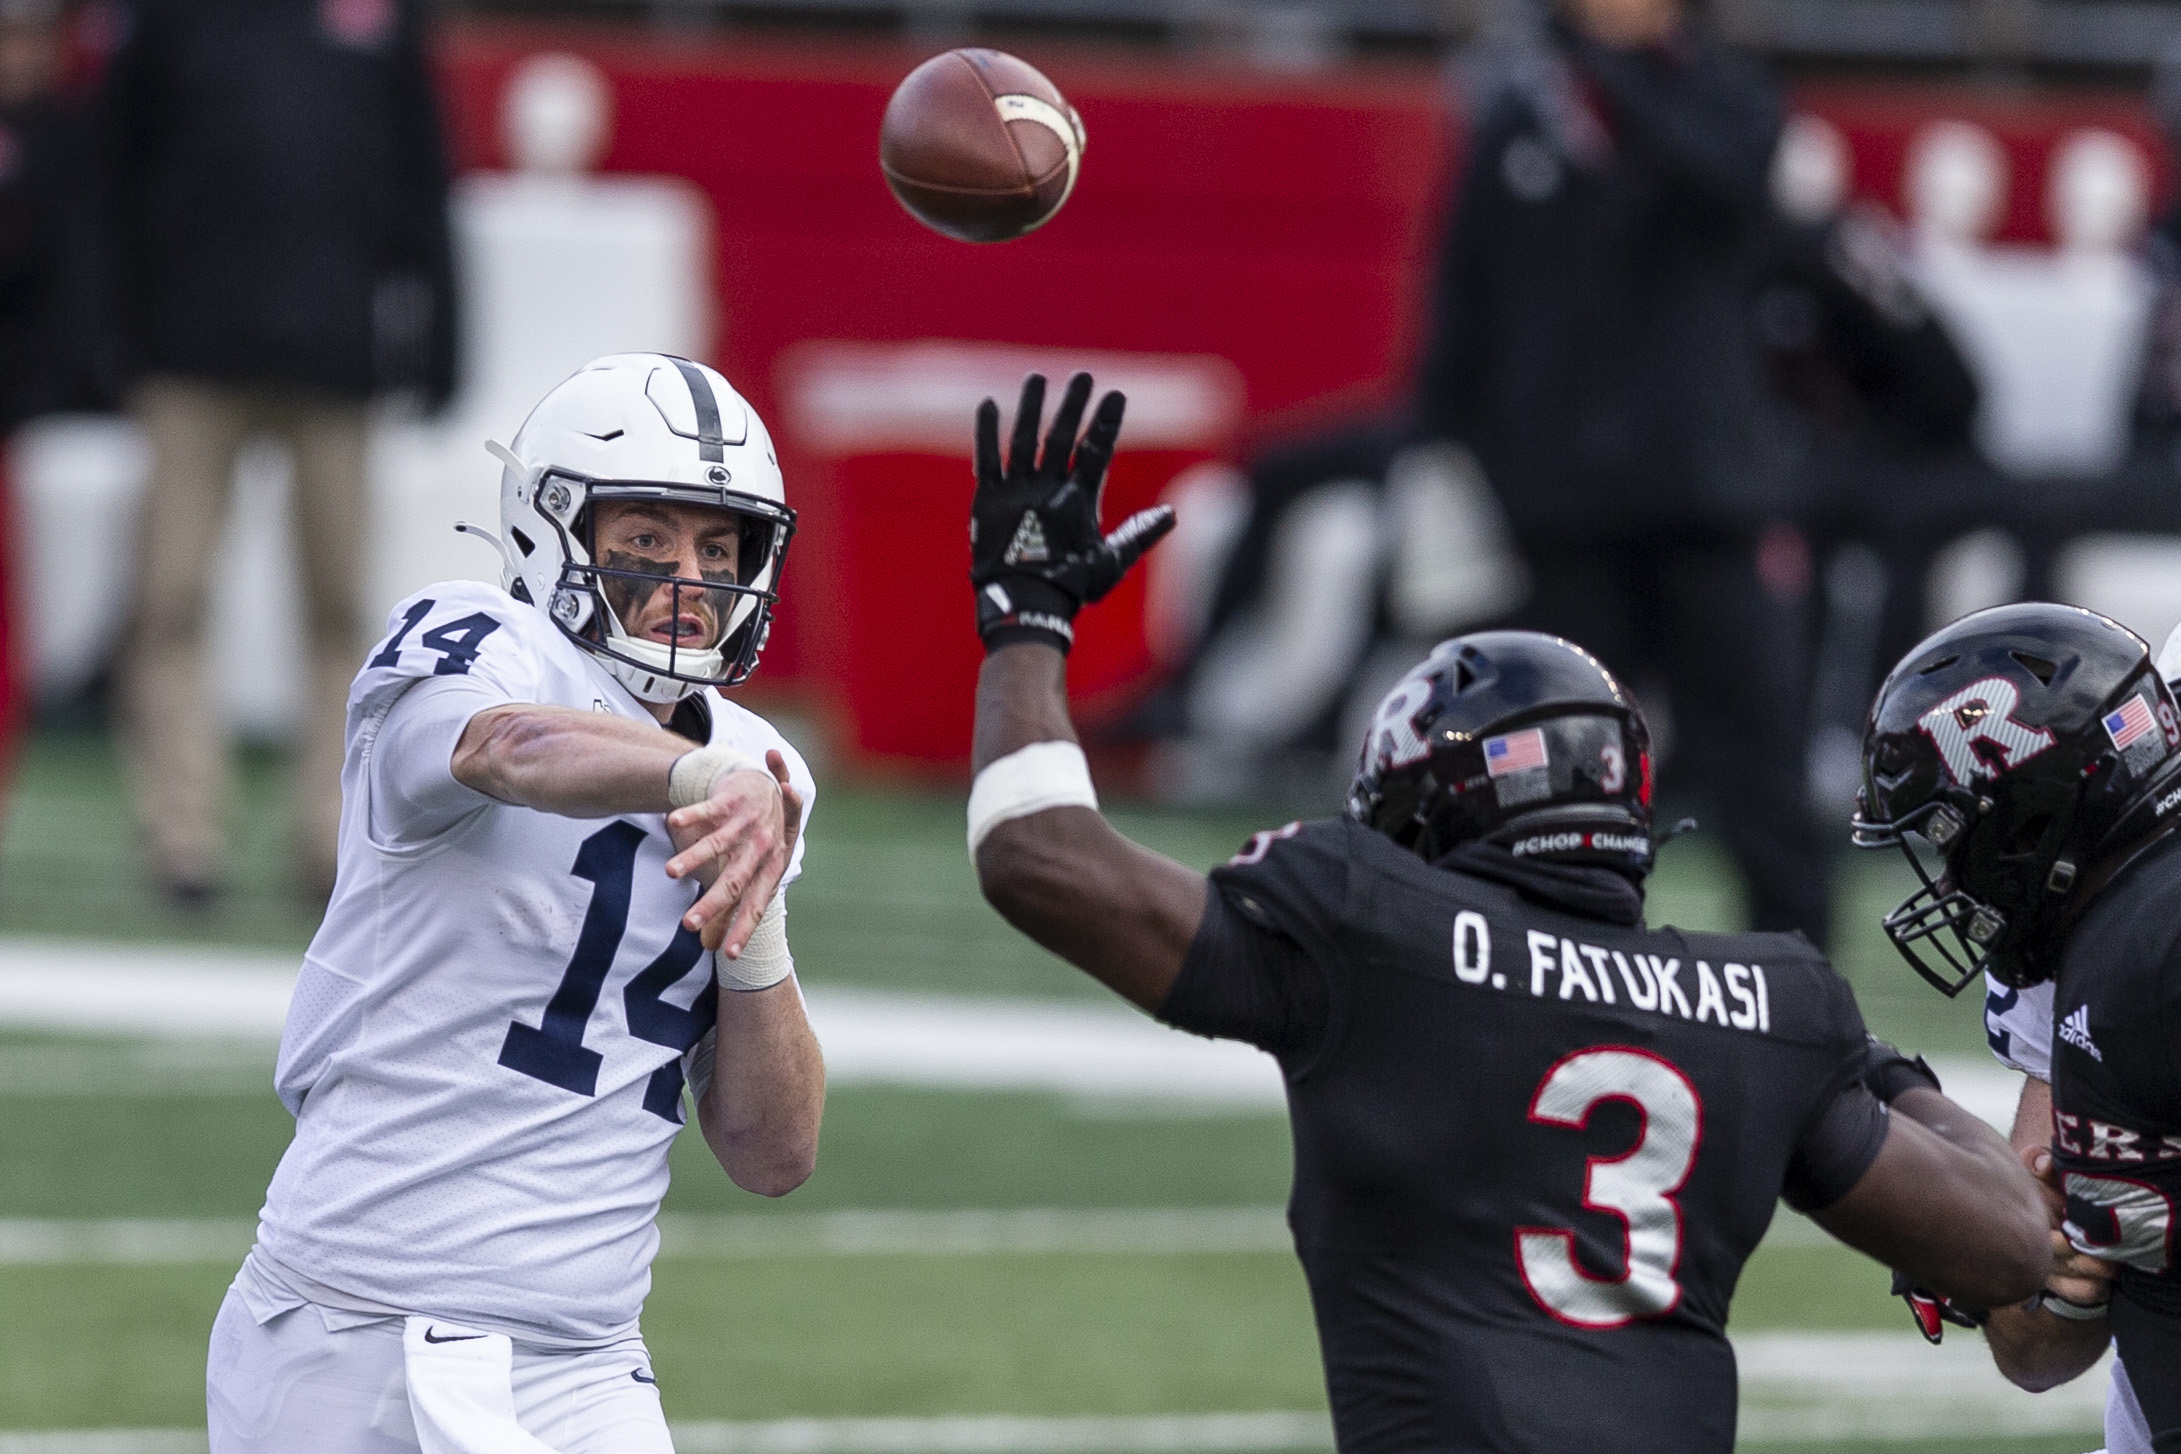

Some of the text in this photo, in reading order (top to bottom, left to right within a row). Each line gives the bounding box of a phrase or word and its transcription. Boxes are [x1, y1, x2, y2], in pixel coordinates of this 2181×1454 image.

[367, 598, 502, 675] 14
[1360, 677, 1433, 782] R
[1599, 745, 1627, 795] 3
[1917, 675, 2057, 789] R
[497, 818, 719, 1126] 14
[1526, 929, 1770, 1033] FATUKASI
[1513, 1043, 1705, 1331] 3
